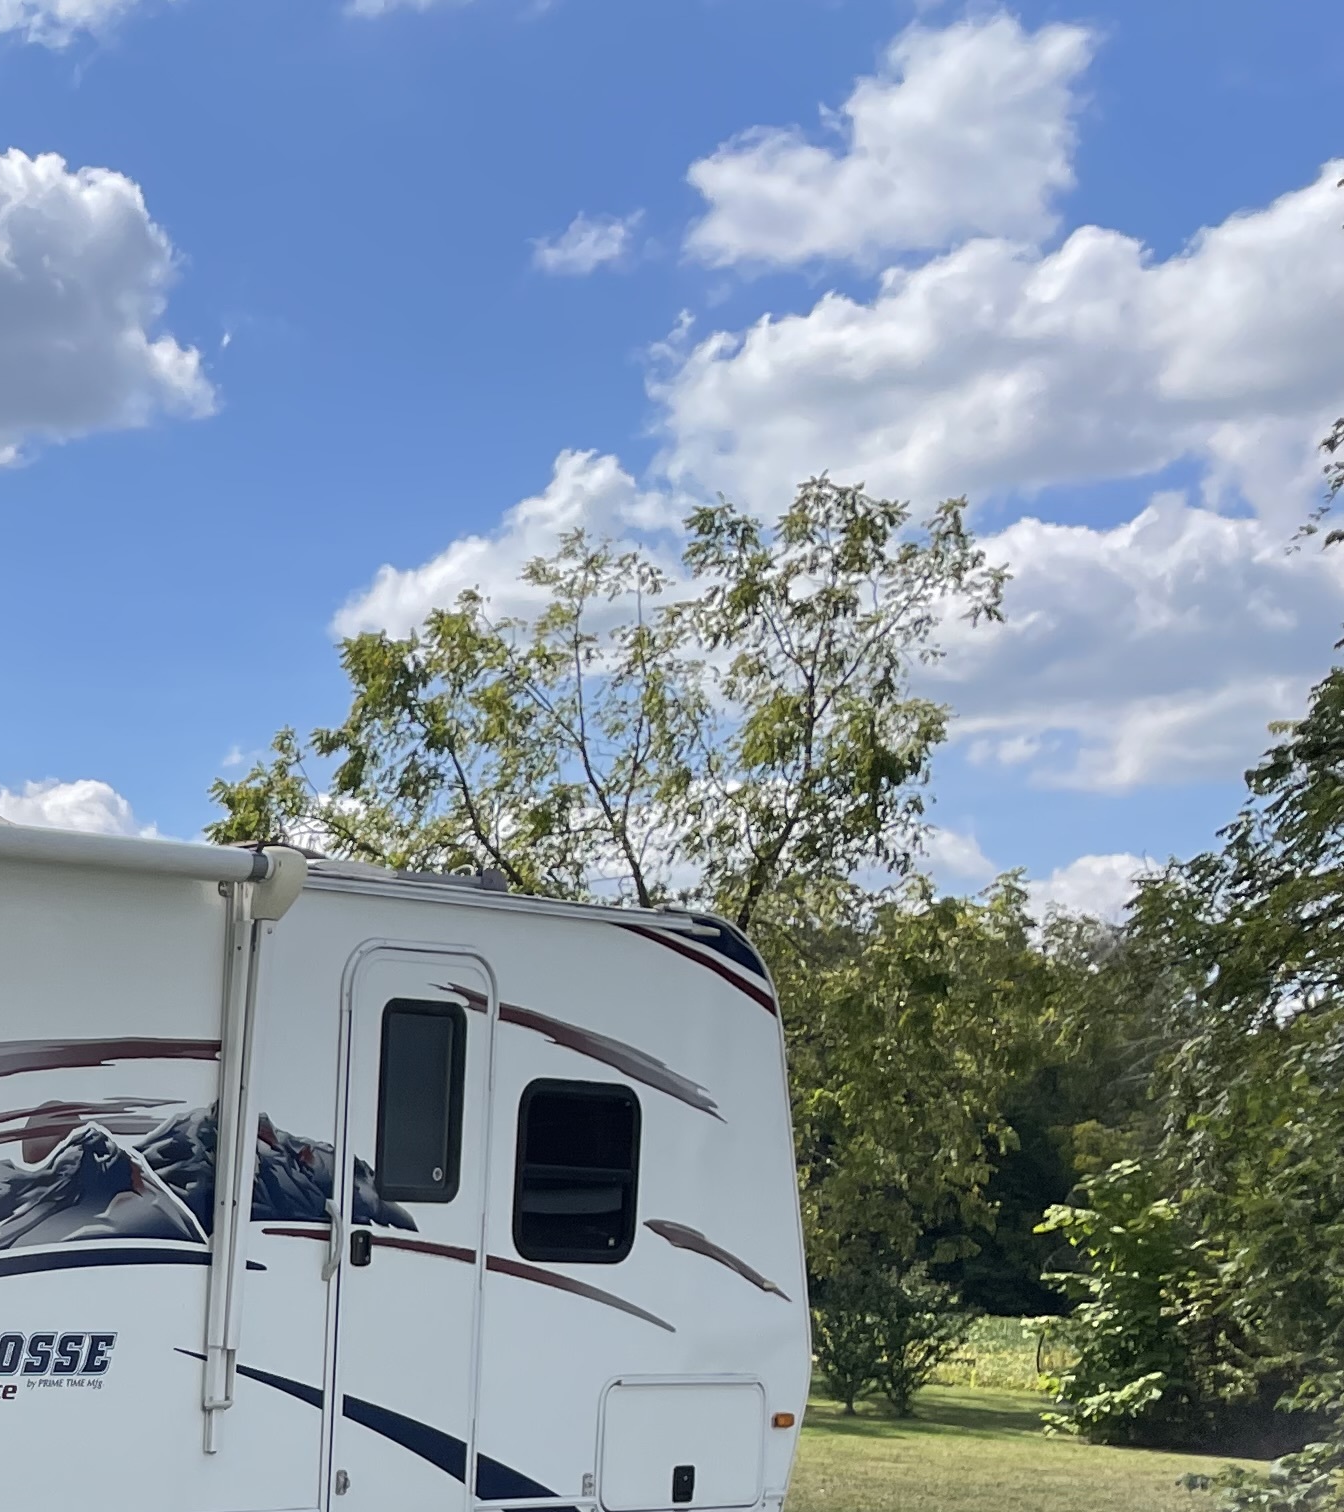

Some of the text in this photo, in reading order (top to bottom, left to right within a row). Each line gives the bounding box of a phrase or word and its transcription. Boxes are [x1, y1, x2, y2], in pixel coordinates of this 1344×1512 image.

[27, 1379, 36, 1389] by
[38, 1379, 63, 1388] PRIME
[66, 1379, 84, 1388] TIME
